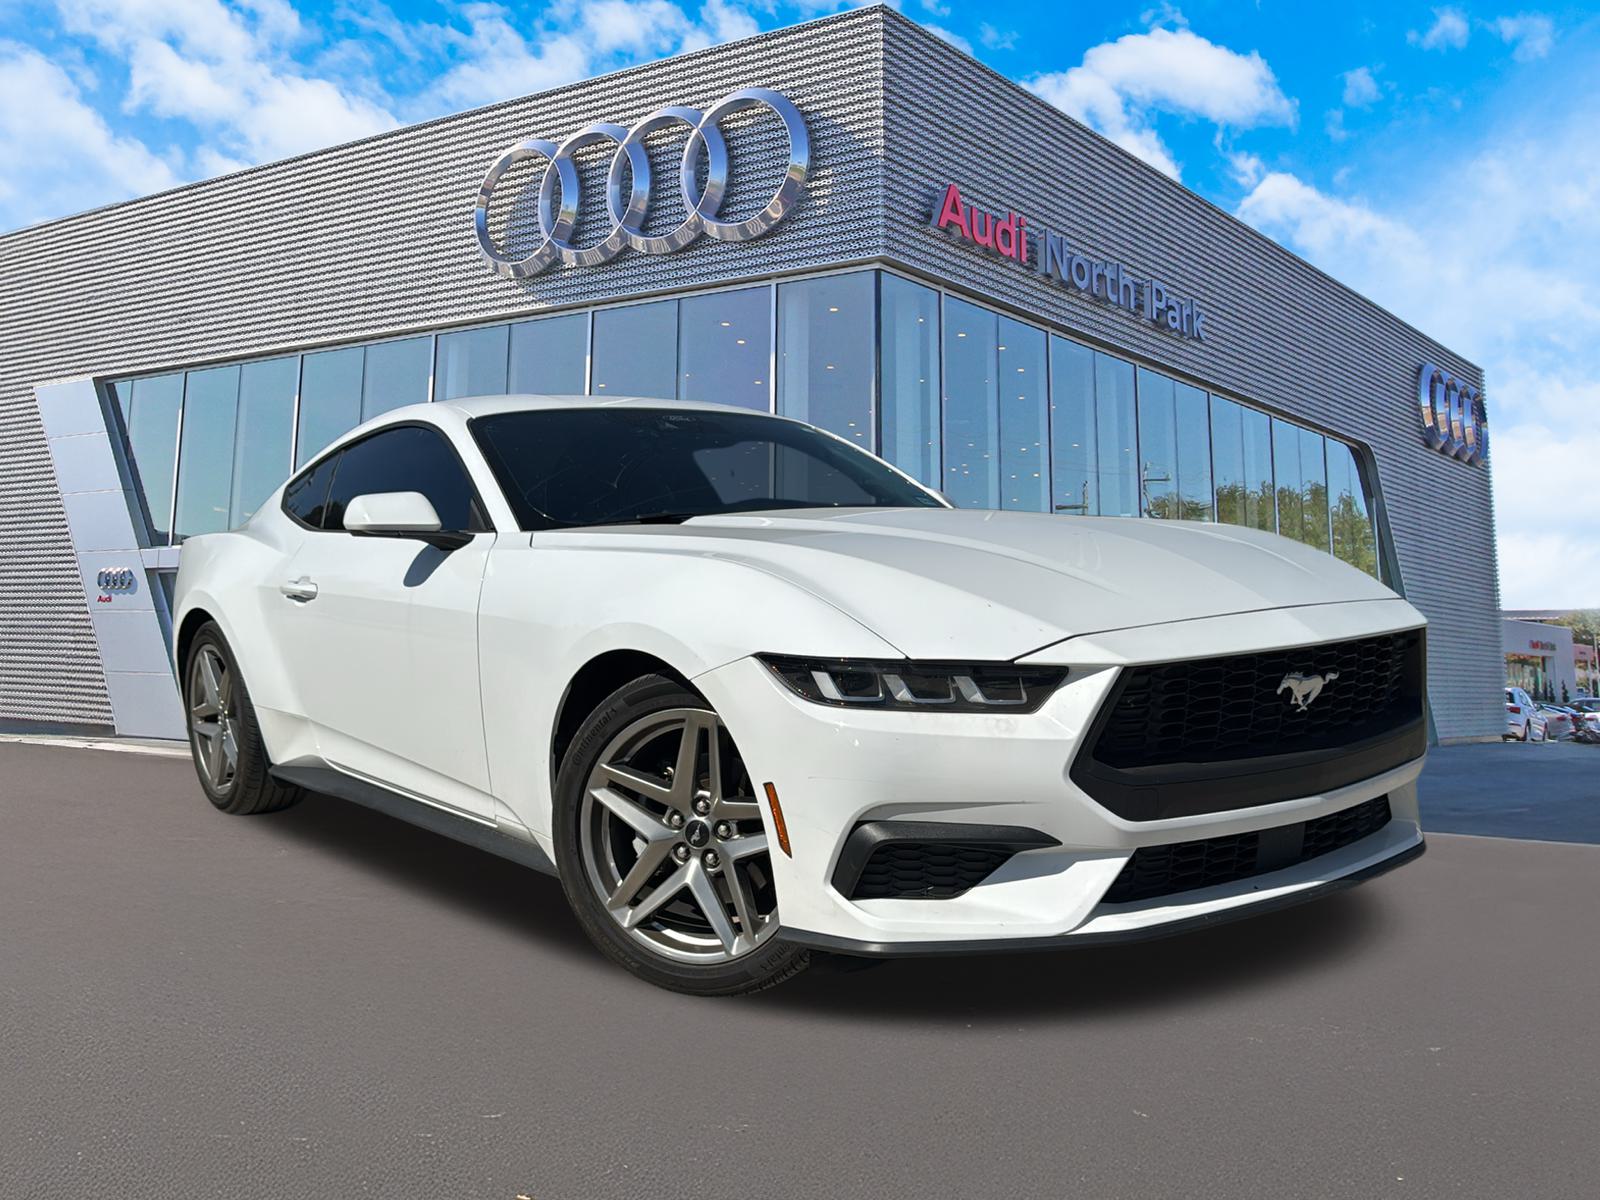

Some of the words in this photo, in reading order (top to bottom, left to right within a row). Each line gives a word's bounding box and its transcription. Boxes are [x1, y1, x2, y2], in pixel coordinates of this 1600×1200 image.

[936, 184, 1027, 264] Audi
[1043, 230, 1136, 310] North
[1150, 279, 1206, 340] Park
